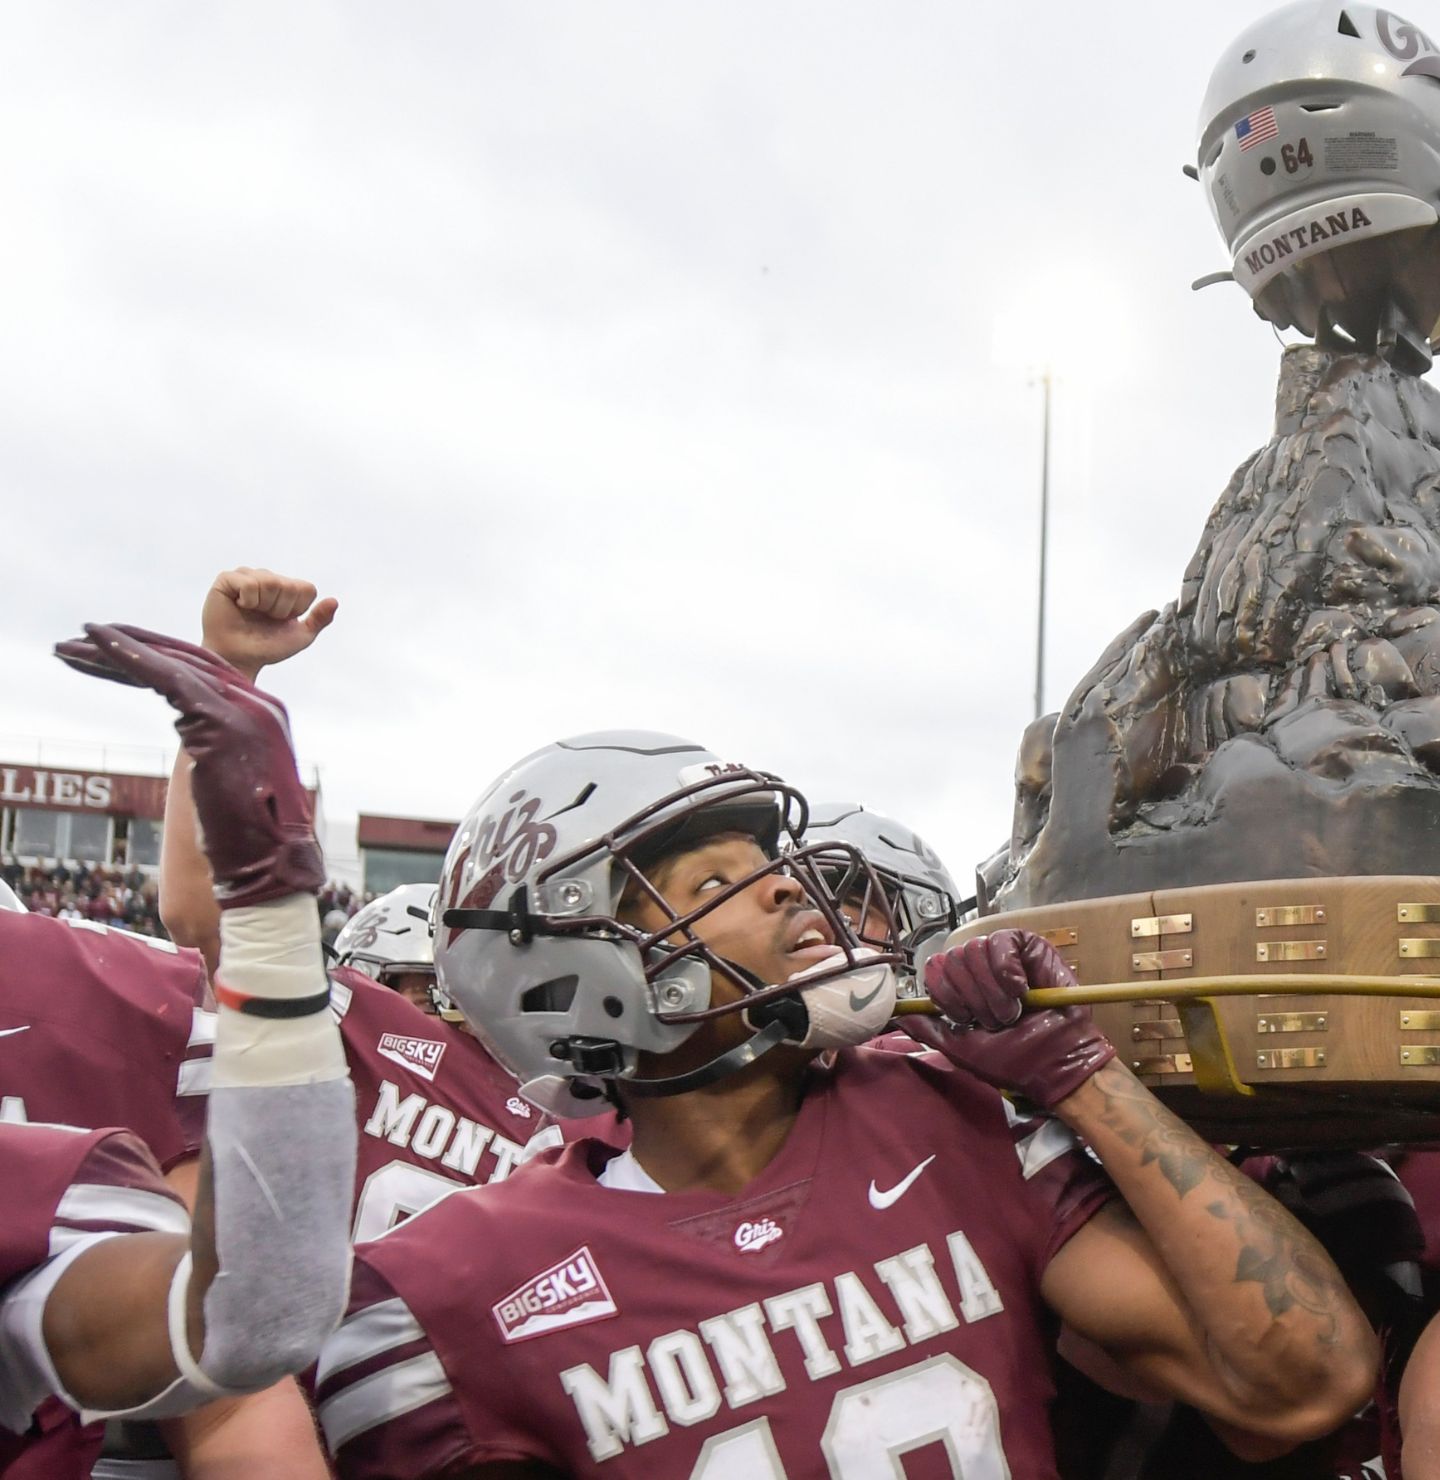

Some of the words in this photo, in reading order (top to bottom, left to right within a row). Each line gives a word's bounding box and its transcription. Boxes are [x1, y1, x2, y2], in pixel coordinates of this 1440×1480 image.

[1280, 137, 1314, 174] 64
[1244, 207, 1373, 276] MONTANA
[0, 767, 113, 809] LIES
[558, 1229, 1005, 1464] MONTANA
